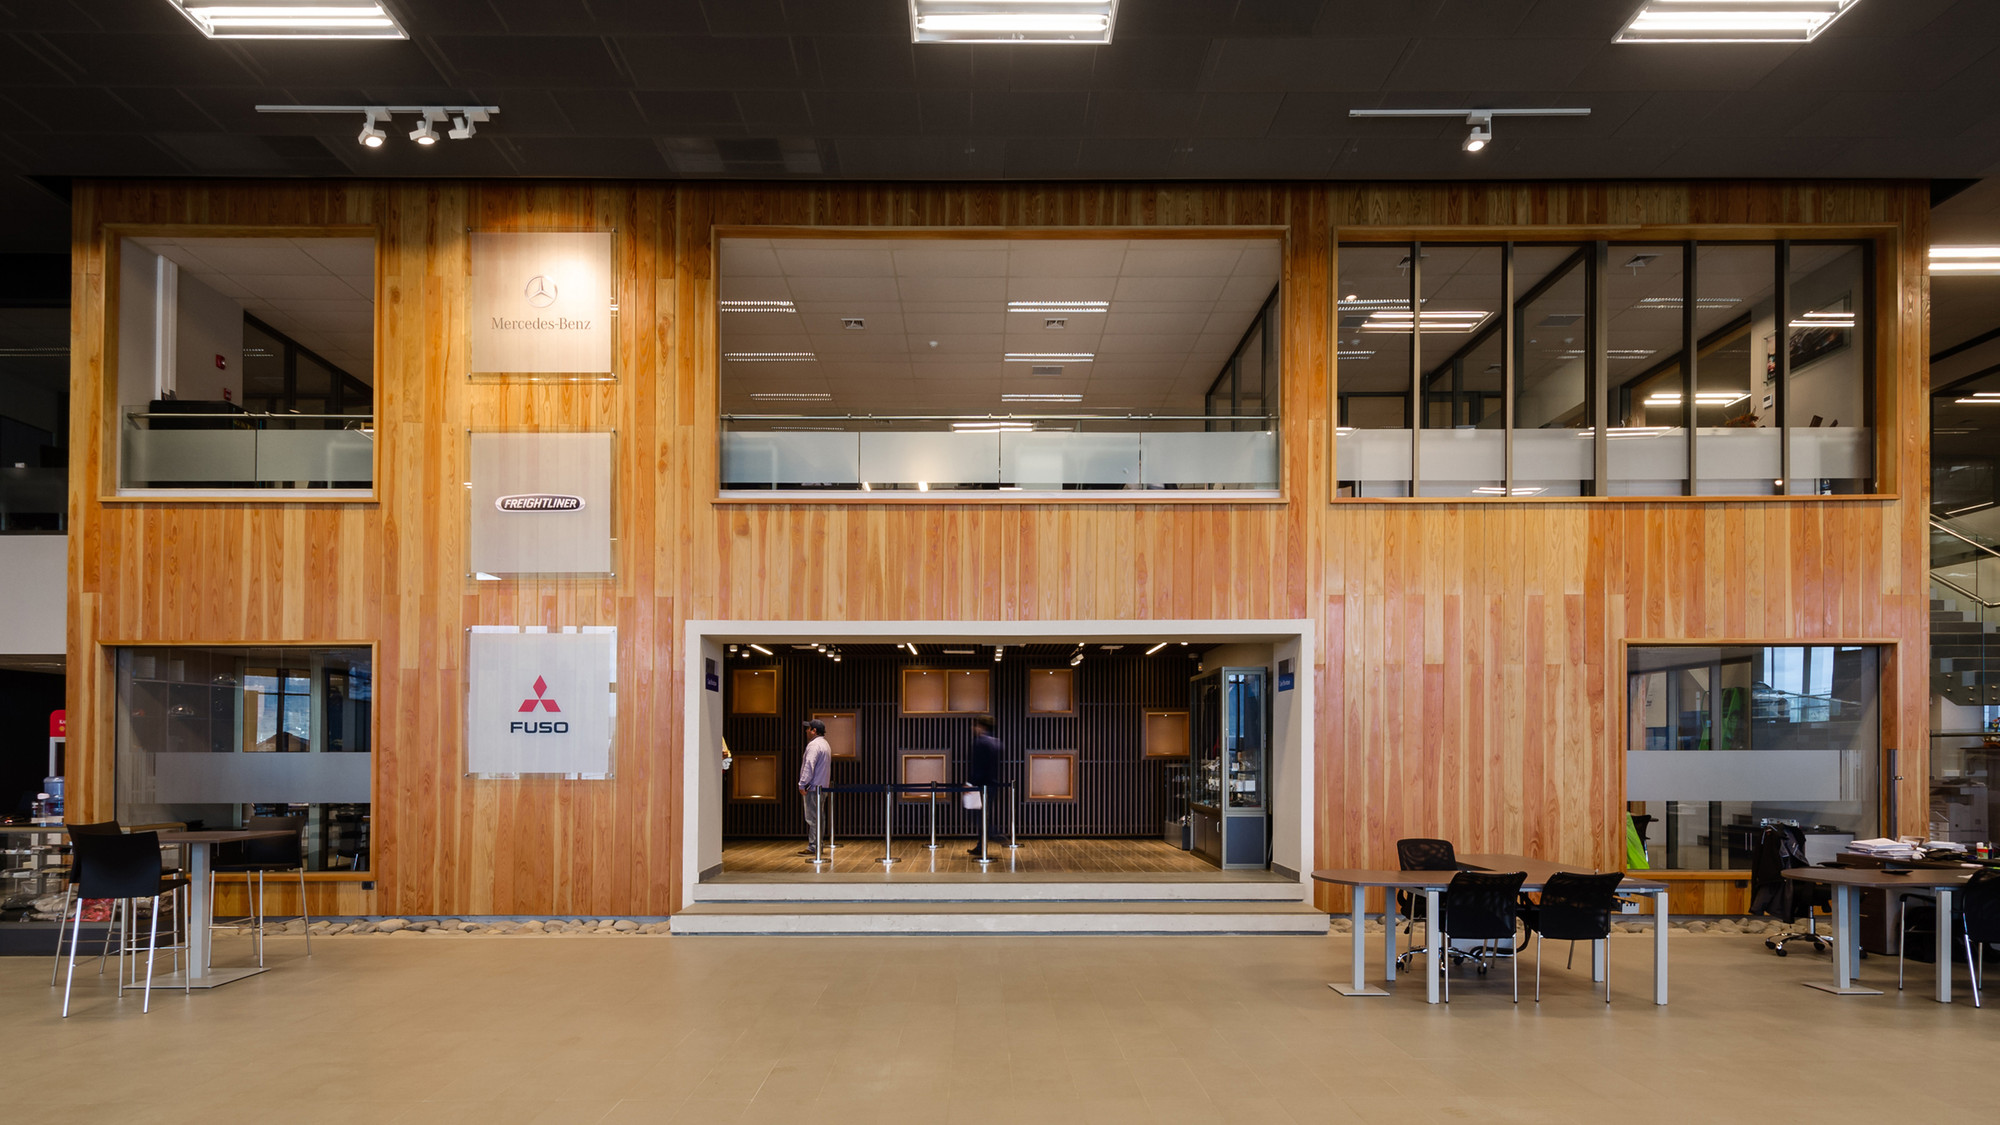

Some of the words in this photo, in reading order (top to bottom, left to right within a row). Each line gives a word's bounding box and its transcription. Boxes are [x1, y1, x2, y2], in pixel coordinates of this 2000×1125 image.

[491, 317, 591, 330] Mercedes-Benz
[504, 498, 577, 509] FREIGHTLINER
[510, 721, 569, 734] FUSO
